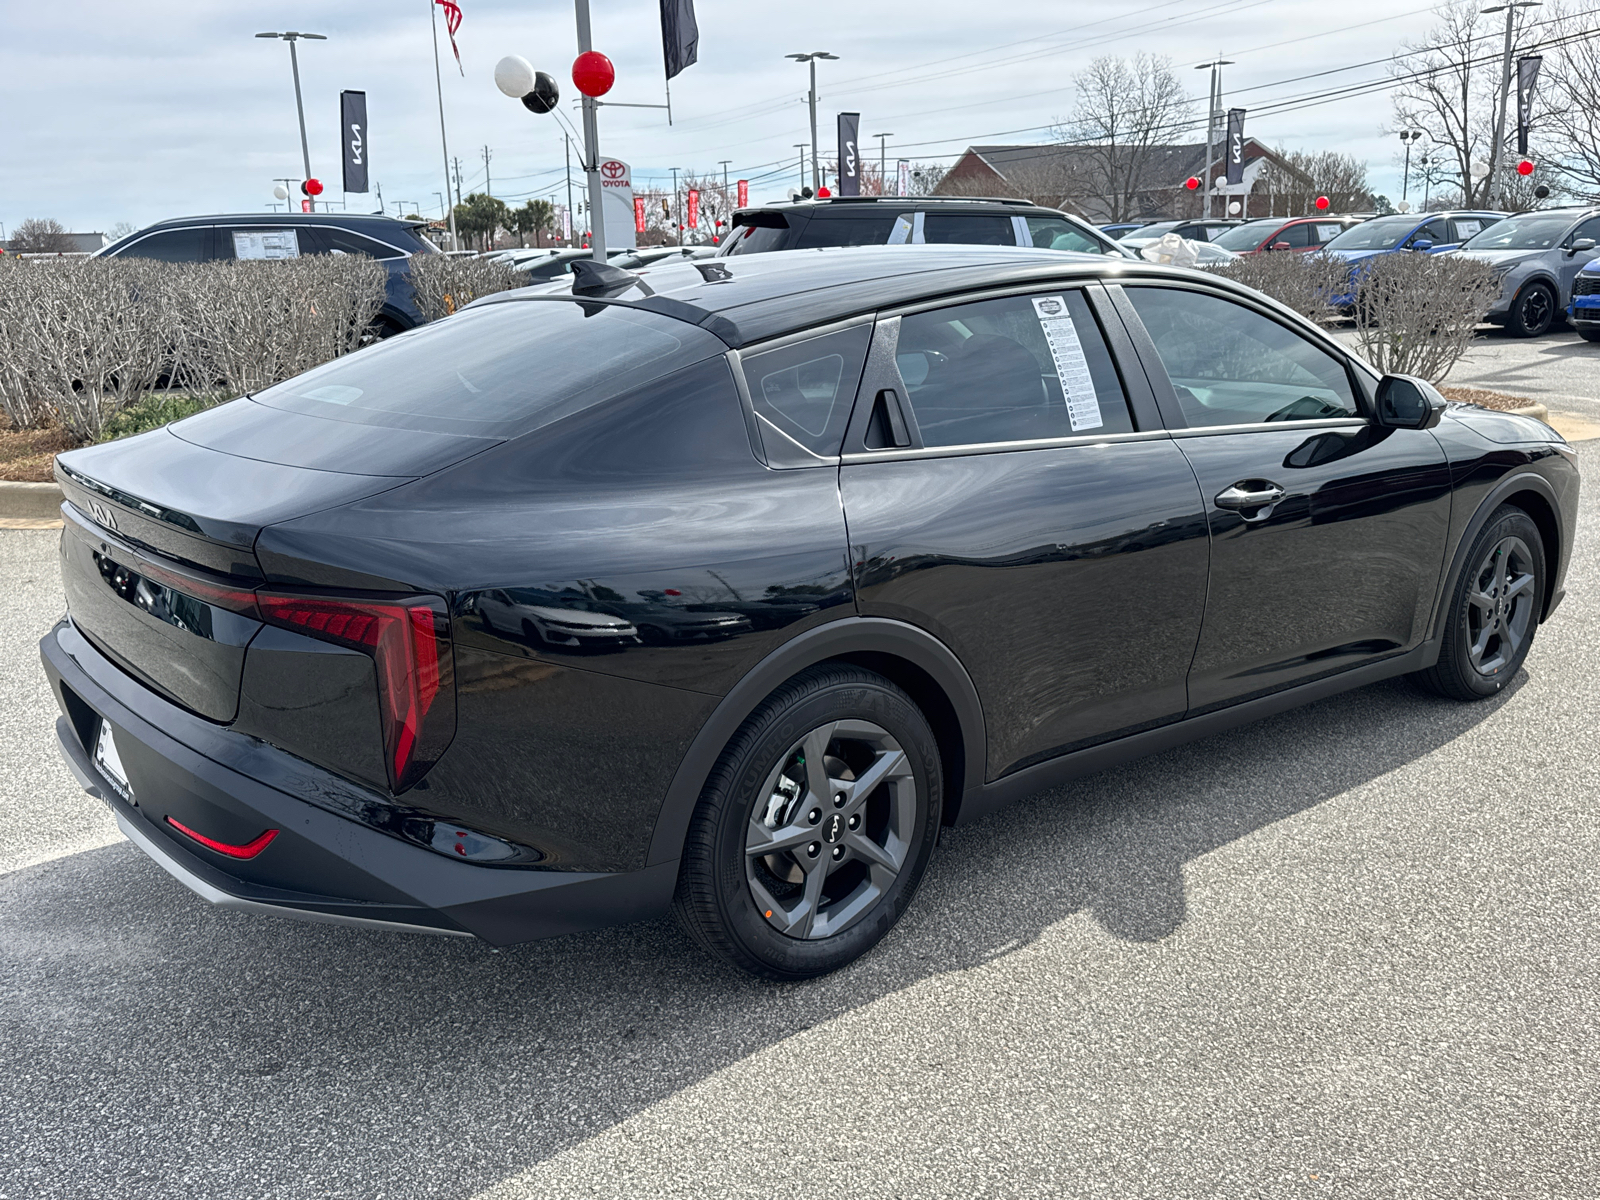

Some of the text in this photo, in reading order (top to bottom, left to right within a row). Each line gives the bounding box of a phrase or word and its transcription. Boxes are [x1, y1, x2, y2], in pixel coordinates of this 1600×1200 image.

[351, 123, 362, 164] KIA
[846, 141, 855, 177] KIA
[1232, 132, 1241, 164] KIA
[87, 500, 118, 530] KIA
[1460, 570, 1476, 629] KUMHO
[736, 723, 794, 805] KUMHO
[829, 815, 840, 843] KIA
